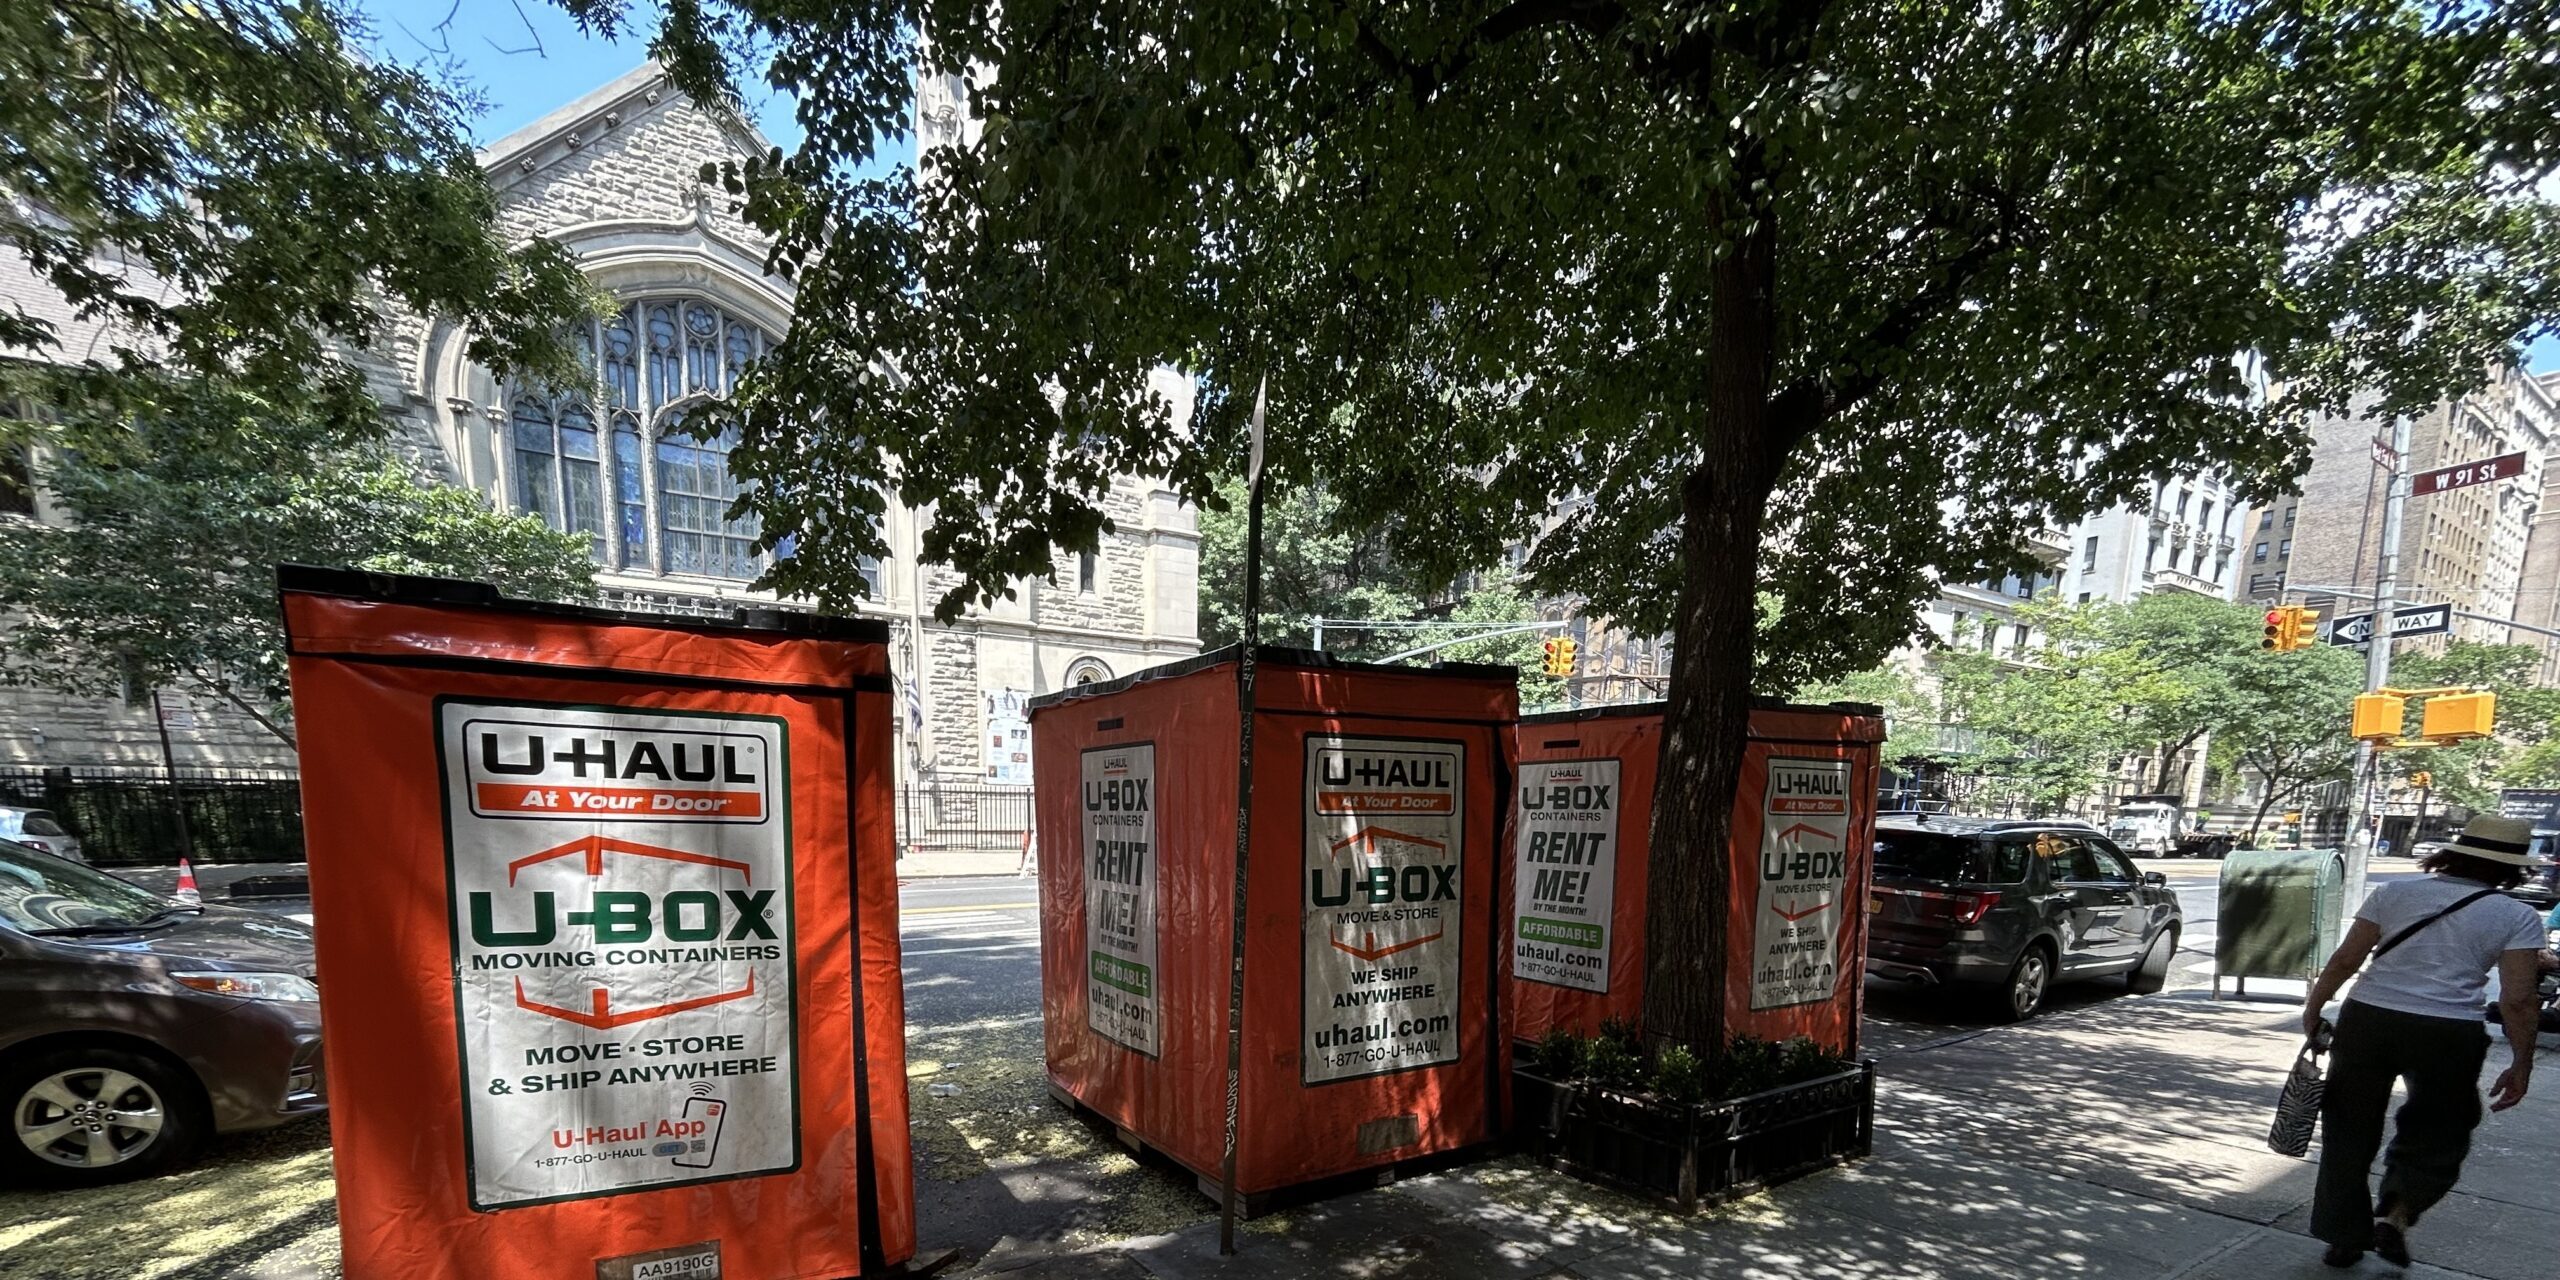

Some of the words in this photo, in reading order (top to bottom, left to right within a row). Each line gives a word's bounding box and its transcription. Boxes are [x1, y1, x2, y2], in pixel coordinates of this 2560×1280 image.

[2436, 474, 2449, 489] W
[2455, 469, 2473, 486] 91
[2479, 463, 2497, 480] St
[2348, 623, 2370, 636] ON
[2397, 614, 2434, 629] WAY
[482, 733, 756, 784] U-HAUL
[1323, 757, 1449, 788] U-HAUL
[1777, 773, 1843, 796] U-HAUL
[521, 789, 558, 808] At
[569, 791, 642, 811] Your
[651, 793, 727, 812] Door
[1086, 778, 1149, 811] U-BOX
[1342, 796, 1361, 808] At
[1364, 795, 1397, 808] Your
[1401, 796, 1438, 808] Door
[1522, 785, 1611, 810] U-BOX
[1785, 801, 1798, 810] At
[1798, 801, 1816, 811] Your
[1816, 801, 1837, 811] Door
[1092, 814, 1144, 827] CONTAINERS
[1530, 811, 1601, 822] CONTAINERS
[1527, 831, 1607, 866] RENT
[1094, 839, 1148, 887] RENT
[1763, 851, 1843, 881] U-BOX
[1312, 864, 1457, 907] U-BOX
[1533, 869, 1591, 904] ME!
[1776, 885, 1799, 894] MOVE
[1800, 884, 1806, 893] &
[1807, 882, 1832, 892] STORE
[469, 889, 779, 947] U-BOX
[1100, 889, 1137, 938] ME!
[1337, 911, 1379, 924] MOVE
[1382, 911, 1391, 922] &
[1394, 907, 1440, 921] STORE
[1533, 902, 1545, 912] BY
[1545, 904, 1557, 913] THE
[1558, 905, 1588, 916] MONTH!
[1523, 921, 1598, 943] AFFORDABLE
[1780, 928, 1794, 938] WE
[1796, 926, 1817, 937] SHIP
[472, 951, 597, 970] MOVING
[606, 946, 780, 966] CONTAINERS
[1517, 943, 1602, 969] uhaul.com
[1769, 939, 1826, 956] ANYWHERE
[1095, 958, 1148, 989] AFFORDABLE
[1352, 970, 1376, 985] WE
[1381, 966, 1419, 983] SHIP
[1521, 962, 1596, 983] 1-877-GO-U-HAUL
[1758, 962, 1831, 985] uhaul.com
[1091, 986, 1152, 1026] uhaul.com
[1333, 984, 1436, 1009] ANYWHERE
[1315, 1014, 1449, 1049] uhaul.com
[526, 1042, 621, 1066] MOVE
[643, 1034, 745, 1057] STORE
[1324, 1039, 1441, 1070] 1-877-GO-U-HAUL
[488, 1078, 513, 1096] &
[521, 1070, 601, 1093] SHIP
[608, 1056, 777, 1086] ANYWHERE
[553, 1121, 648, 1149] U-Haul
[656, 1118, 706, 1140] App
[534, 1147, 647, 1169] 1-877-GO-U-HAUL
[660, 1143, 680, 1154] GET
[638, 1254, 714, 1279] AA9190G
